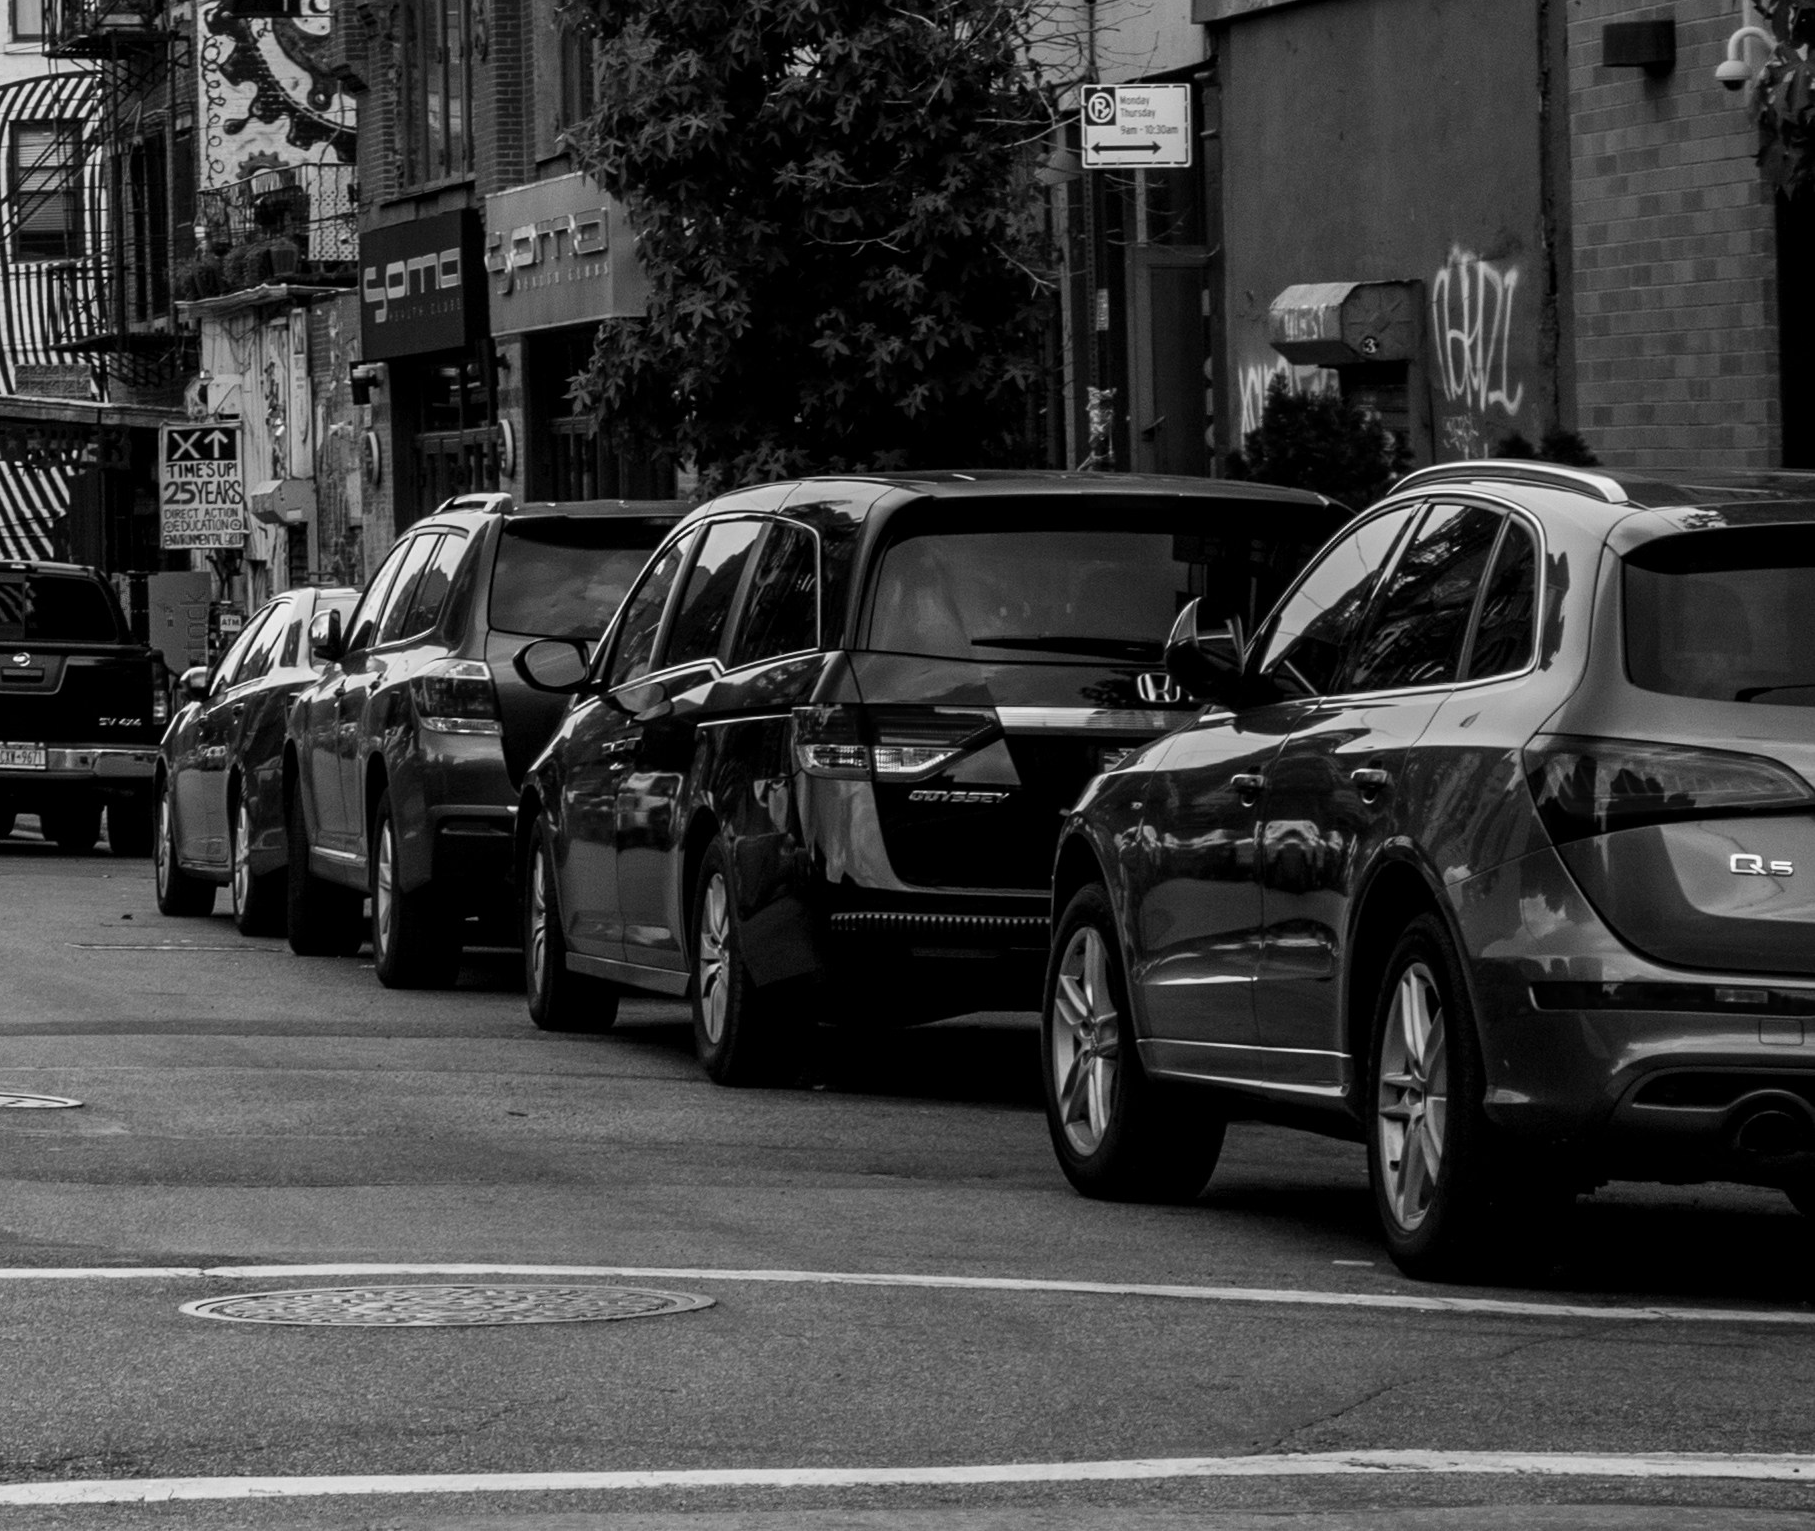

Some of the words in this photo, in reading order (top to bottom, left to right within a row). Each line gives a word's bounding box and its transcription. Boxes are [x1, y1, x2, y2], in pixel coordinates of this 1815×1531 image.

[1120, 96, 1150, 106] Monday
[1120, 108, 1156, 119] Thursday
[1120, 124, 1138, 135] 9am
[163, 508, 199, 520] DIRECT
[204, 508, 238, 520] ACTION
[173, 518, 229, 532] EDUCATION
[221, 618, 240, 627] ATM
[908, 789, 1010, 804] ODYSSEY
[1730, 853, 1794, 876] Q5
